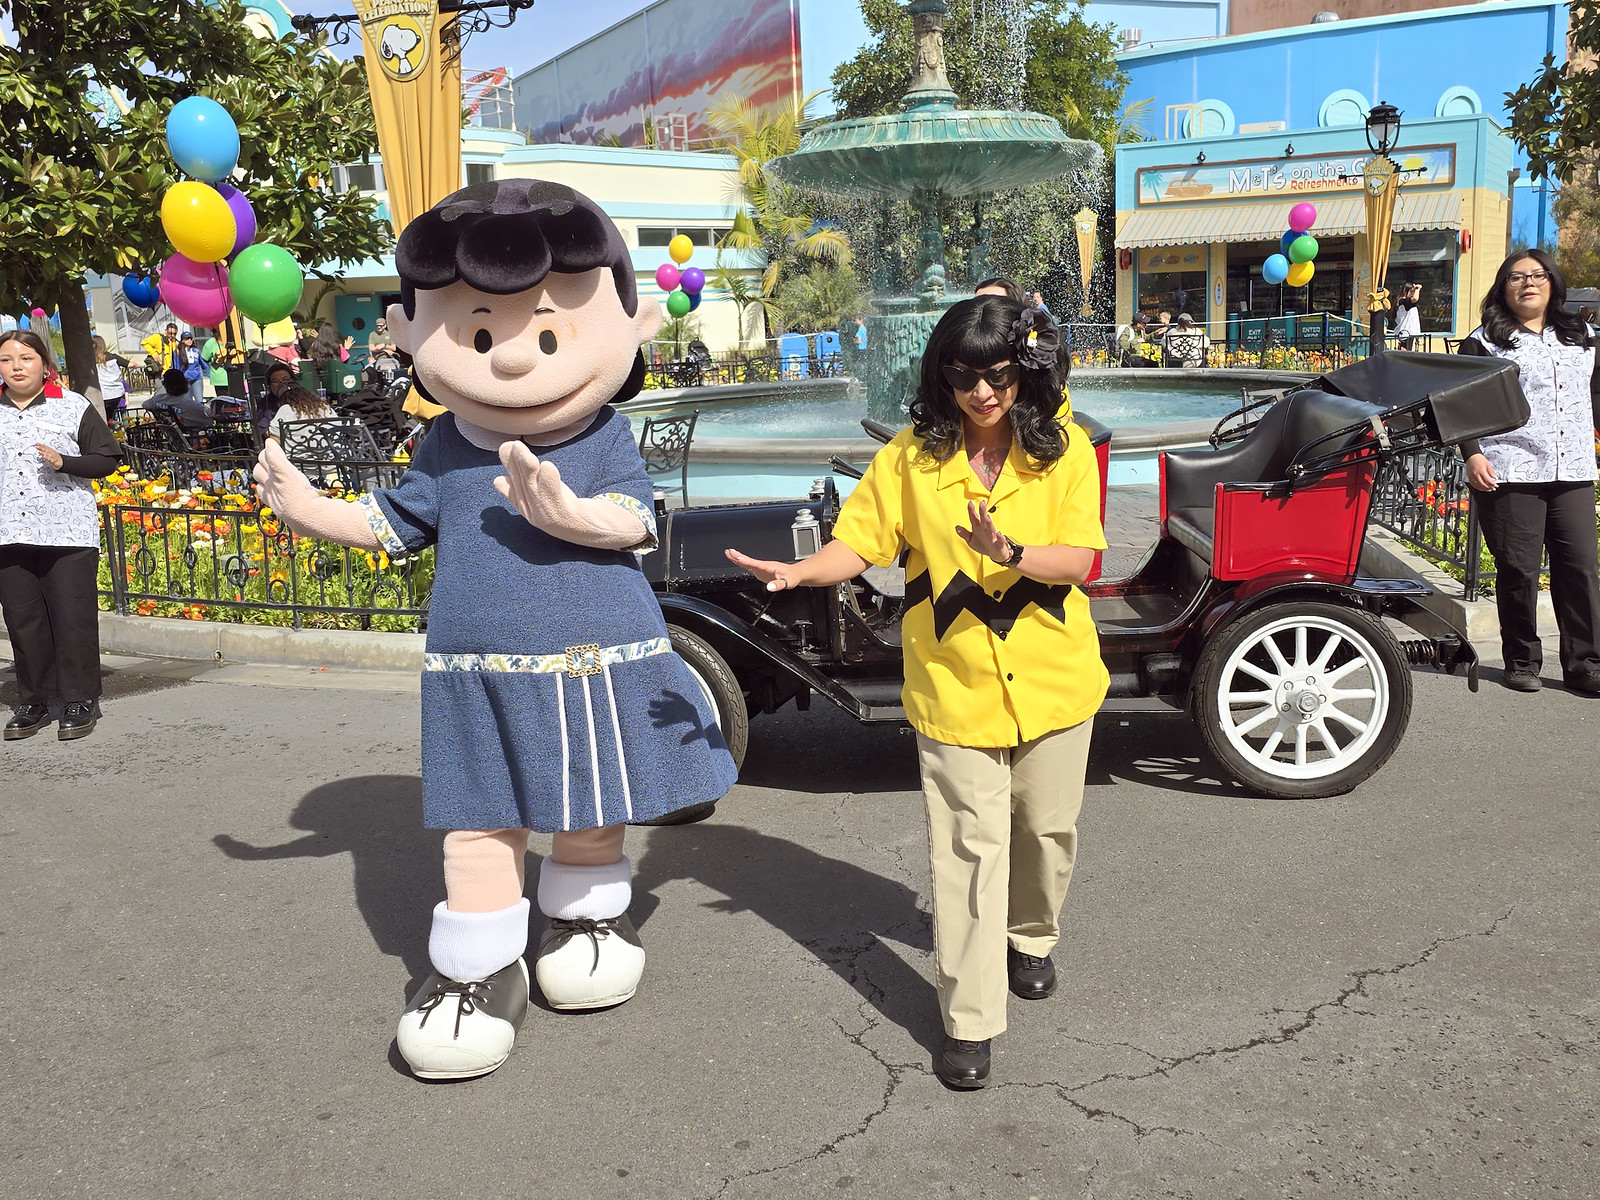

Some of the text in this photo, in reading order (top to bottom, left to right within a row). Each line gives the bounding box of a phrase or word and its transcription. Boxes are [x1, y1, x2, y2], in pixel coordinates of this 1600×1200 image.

[363, 3, 429, 21] CELEBRATION
[1291, 167, 1312, 179] on
[1317, 161, 1346, 177] the
[1291, 177, 1357, 190] Refreshments
